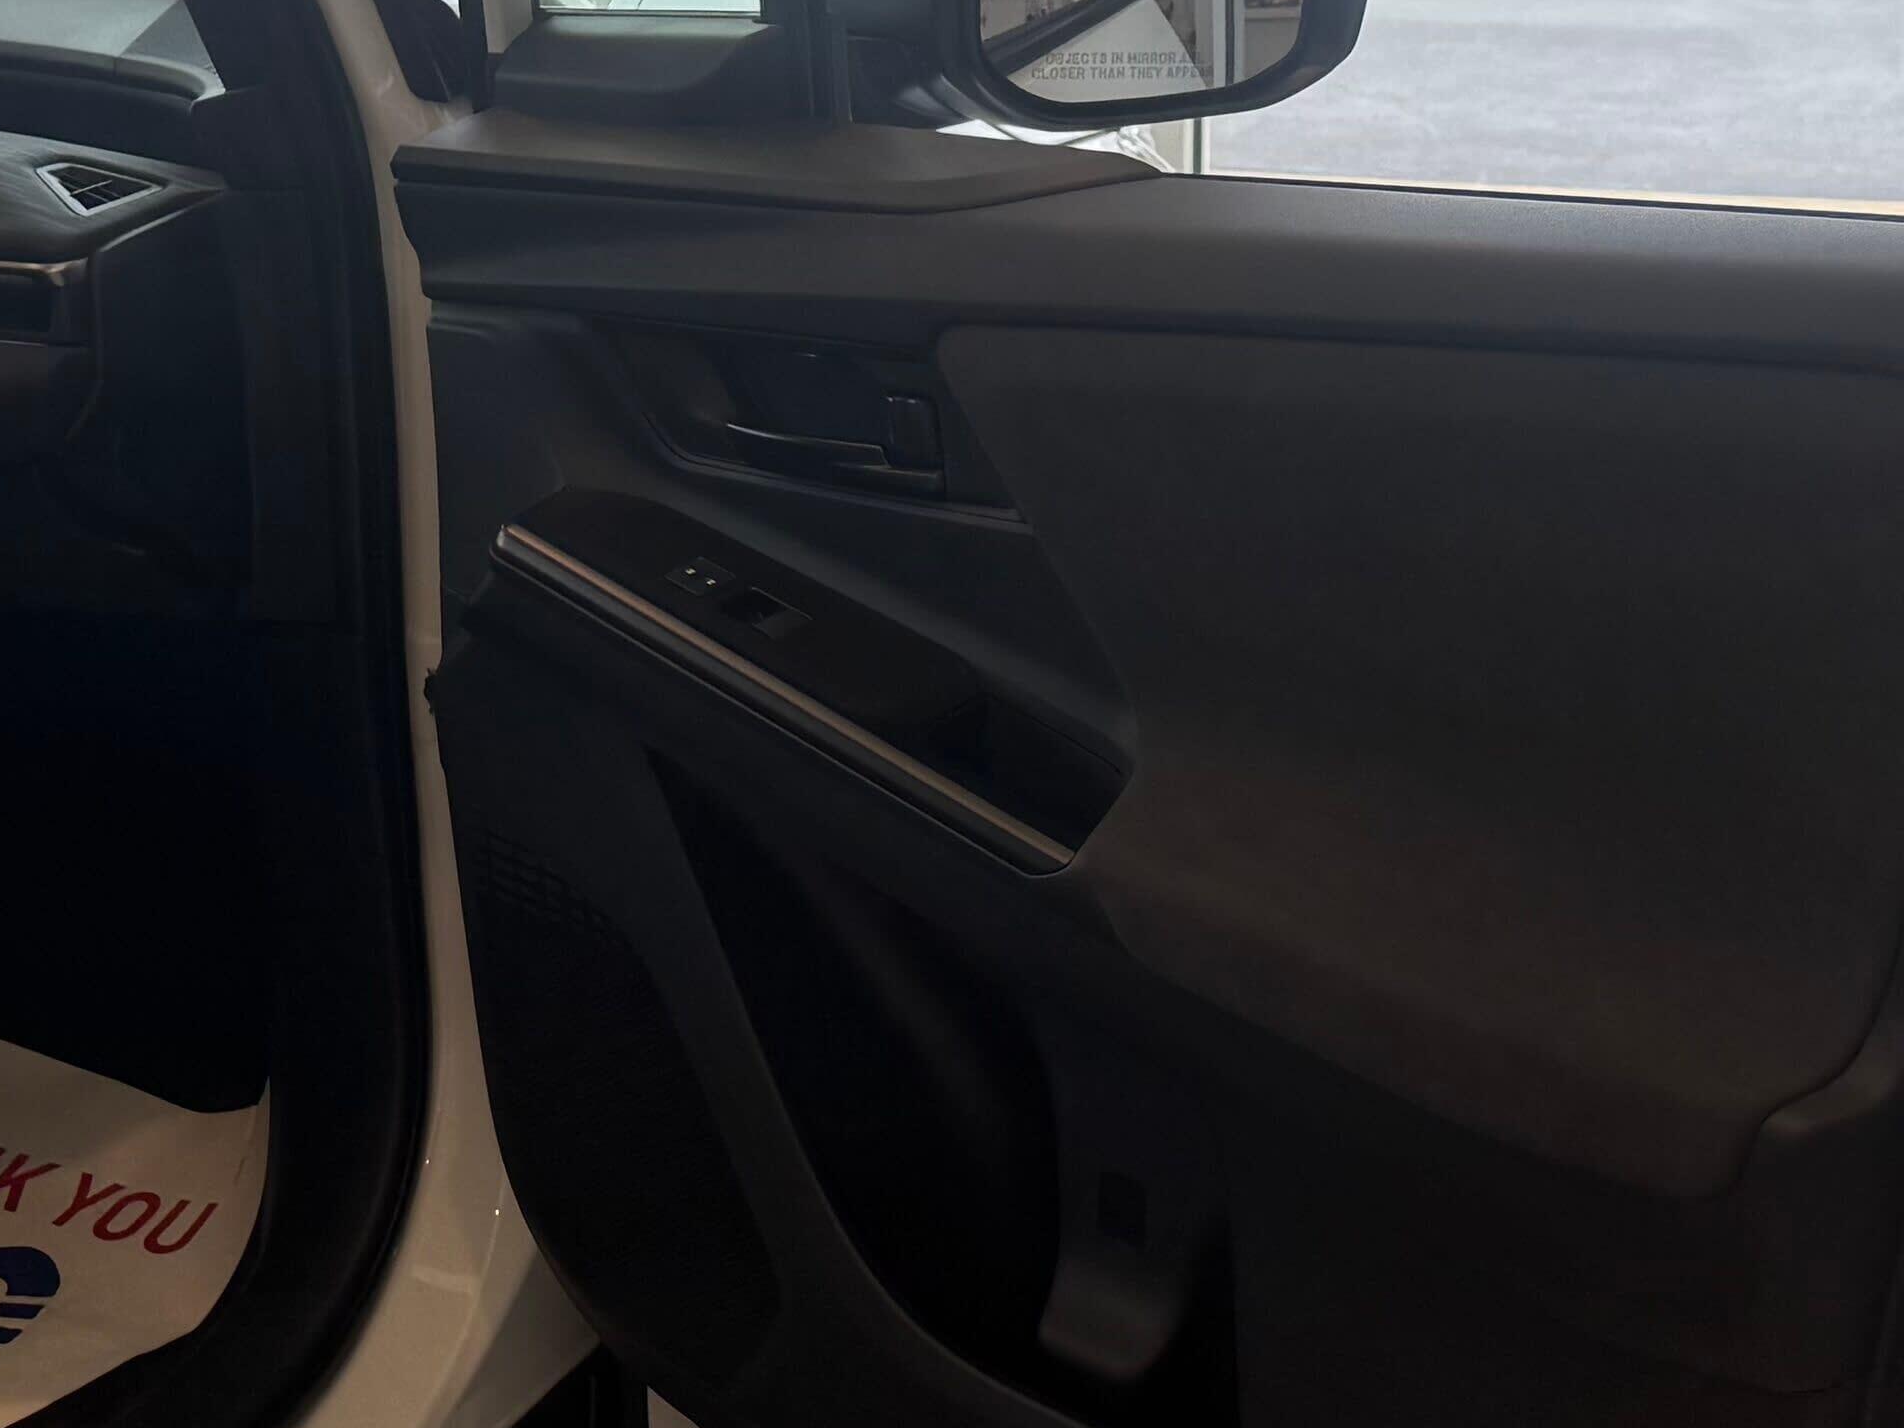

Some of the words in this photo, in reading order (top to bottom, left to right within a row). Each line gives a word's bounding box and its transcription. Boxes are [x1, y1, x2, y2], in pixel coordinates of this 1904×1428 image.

[1046, 52, 1107, 65] OBJECTS
[1111, 51, 1124, 64] IN
[1128, 51, 1176, 64] MIRROR
[1032, 66, 1085, 80] CLOSER
[1090, 65, 1125, 79] THAN
[1130, 65, 1162, 79] THEY
[52, 1172, 218, 1255] YOU
